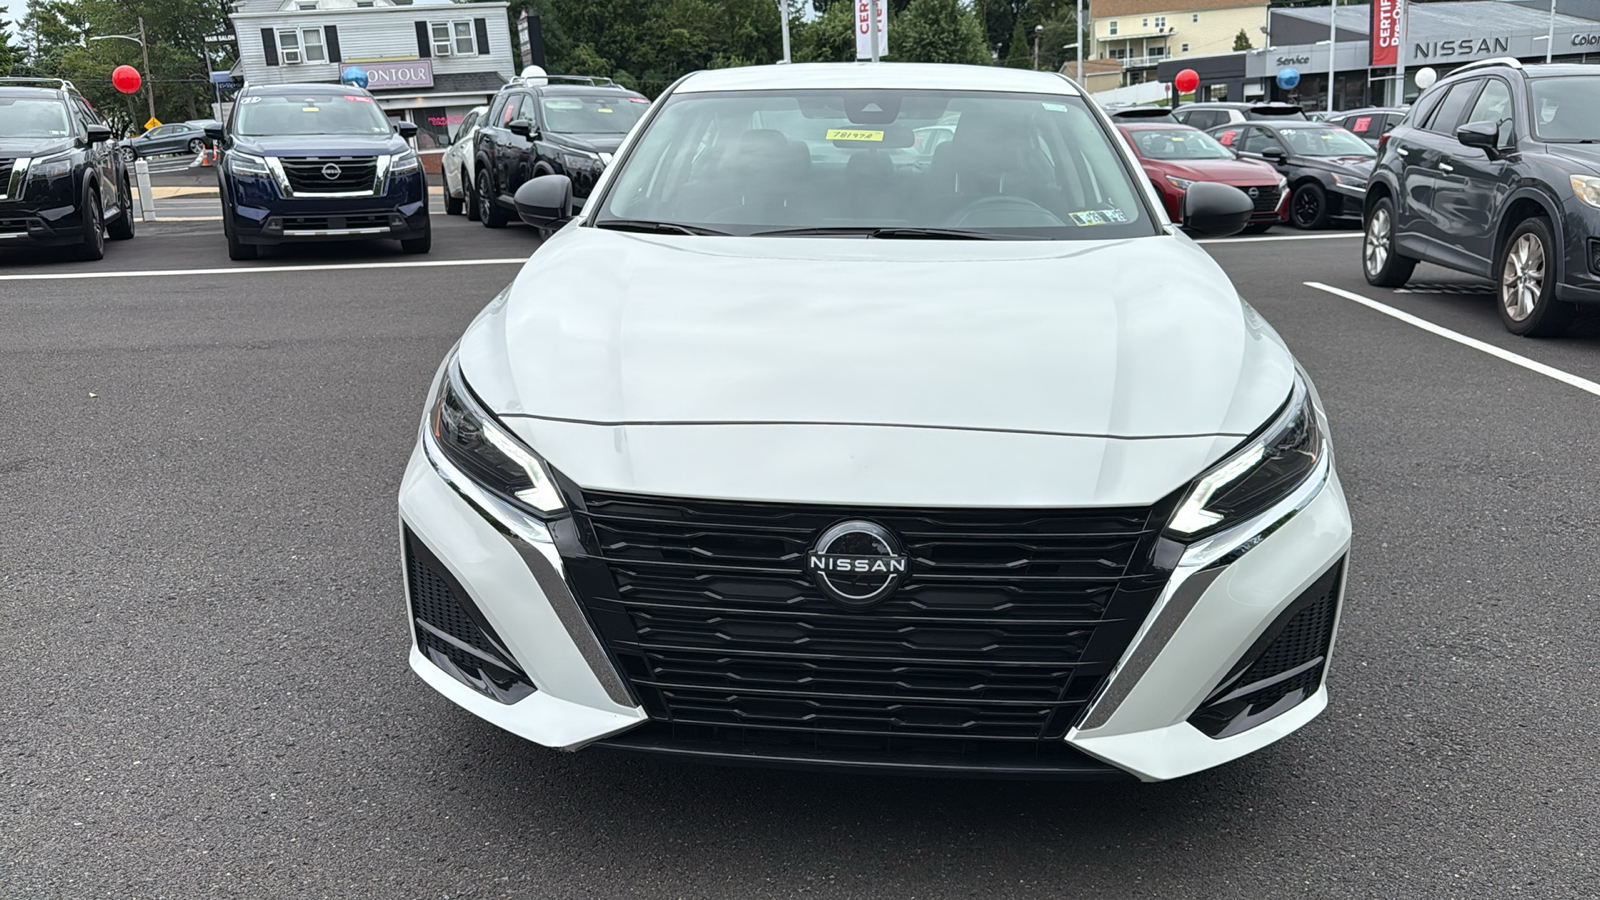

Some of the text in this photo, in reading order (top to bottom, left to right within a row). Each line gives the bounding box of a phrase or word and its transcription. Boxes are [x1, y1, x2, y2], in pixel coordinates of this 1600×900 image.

[859, 0, 869, 35] CER
[1414, 37, 1509, 59] NISSAN
[1276, 55, 1310, 66] Service
[367, 68, 426, 82] ONTOUR
[810, 556, 905, 572] NISSAN
